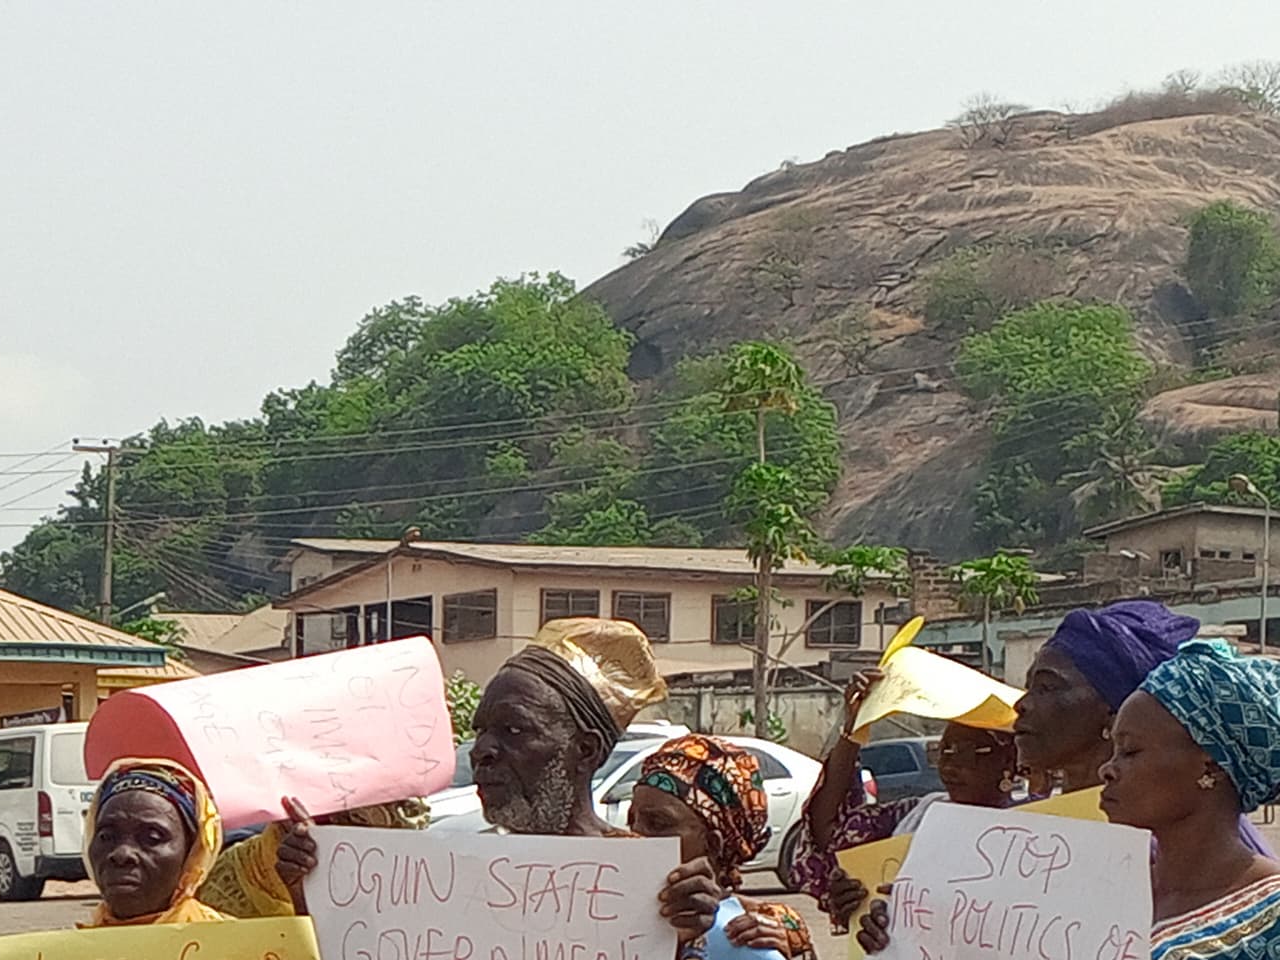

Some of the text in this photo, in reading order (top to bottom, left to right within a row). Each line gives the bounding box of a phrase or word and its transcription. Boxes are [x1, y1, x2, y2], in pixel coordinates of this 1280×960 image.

[328, 841, 625, 922] OGUN STATE
[947, 826, 1072, 894] STOP
[890, 877, 934, 933] THE
